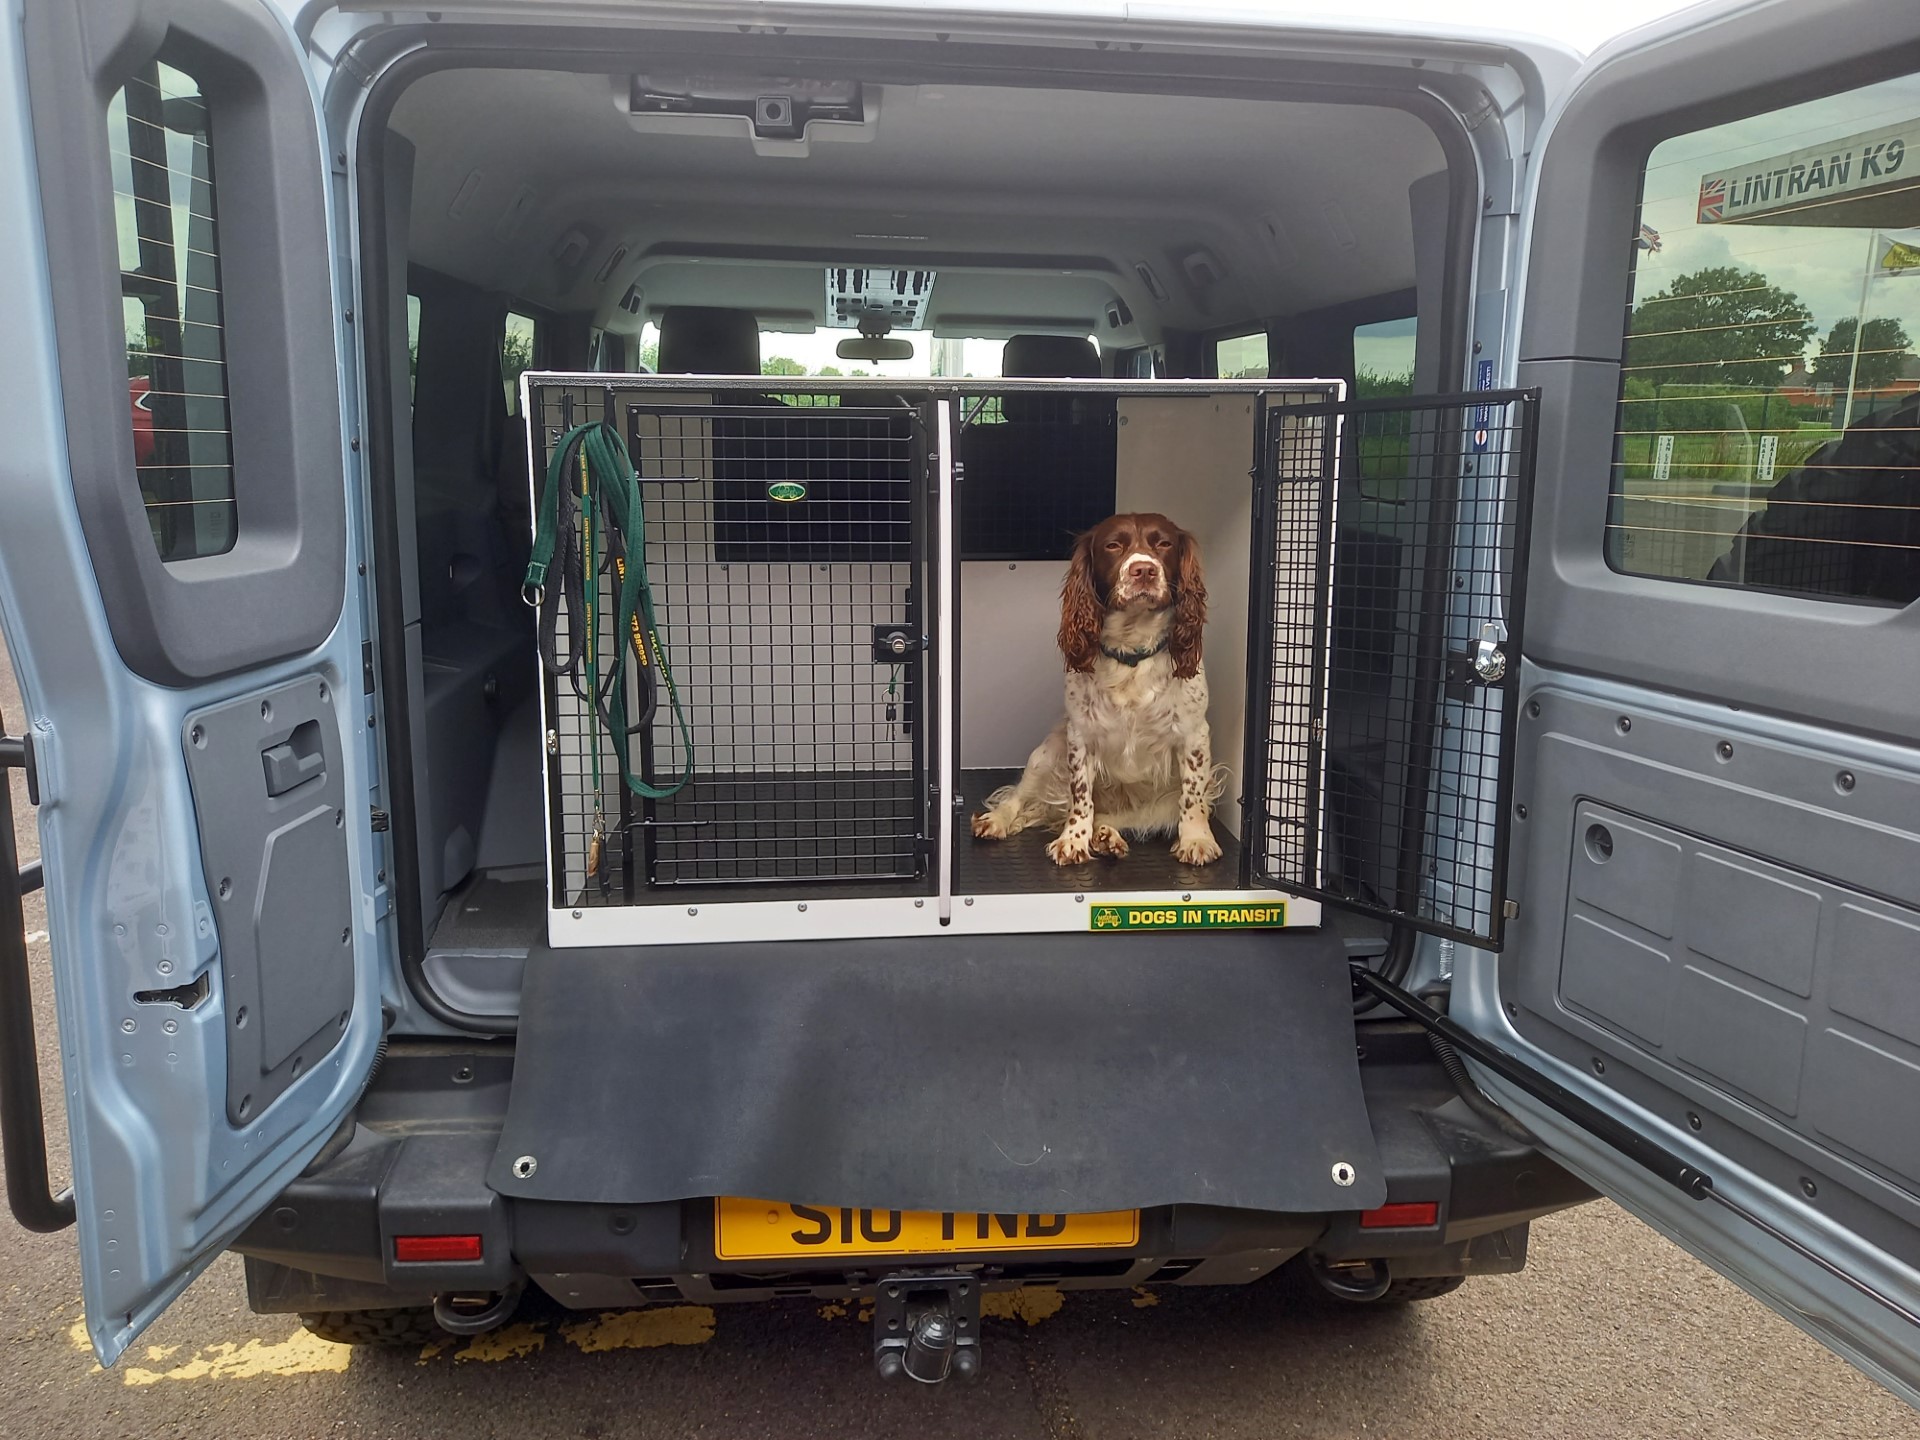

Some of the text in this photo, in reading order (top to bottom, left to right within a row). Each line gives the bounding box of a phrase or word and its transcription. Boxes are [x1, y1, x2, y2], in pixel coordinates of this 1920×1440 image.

[1729, 139, 1905, 209] LINTRAN K9
[1129, 911, 1177, 925] DOGS
[1182, 911, 1202, 924] IN
[1207, 909, 1280, 923] TRANSIT
